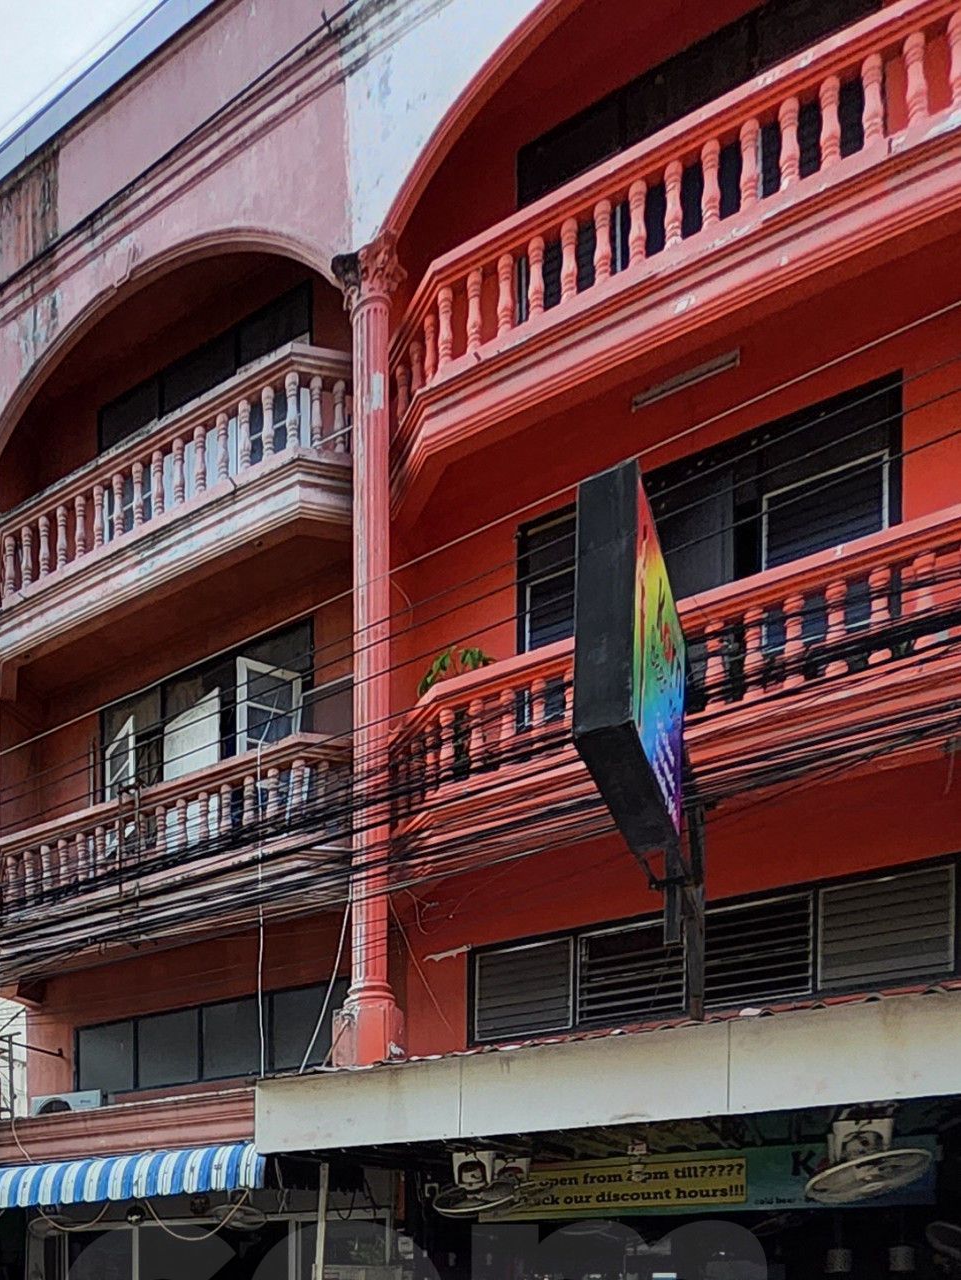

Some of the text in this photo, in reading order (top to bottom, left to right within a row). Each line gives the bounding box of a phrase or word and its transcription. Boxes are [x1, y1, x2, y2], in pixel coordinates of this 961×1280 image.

[539, 1177, 578, 1189] open
[583, 1171, 623, 1186] from
[673, 1163, 745, 1180] till?????
[563, 1194, 592, 1206] our
[596, 1185, 672, 1203] discount
[675, 1184, 745, 1200] hours!!!
